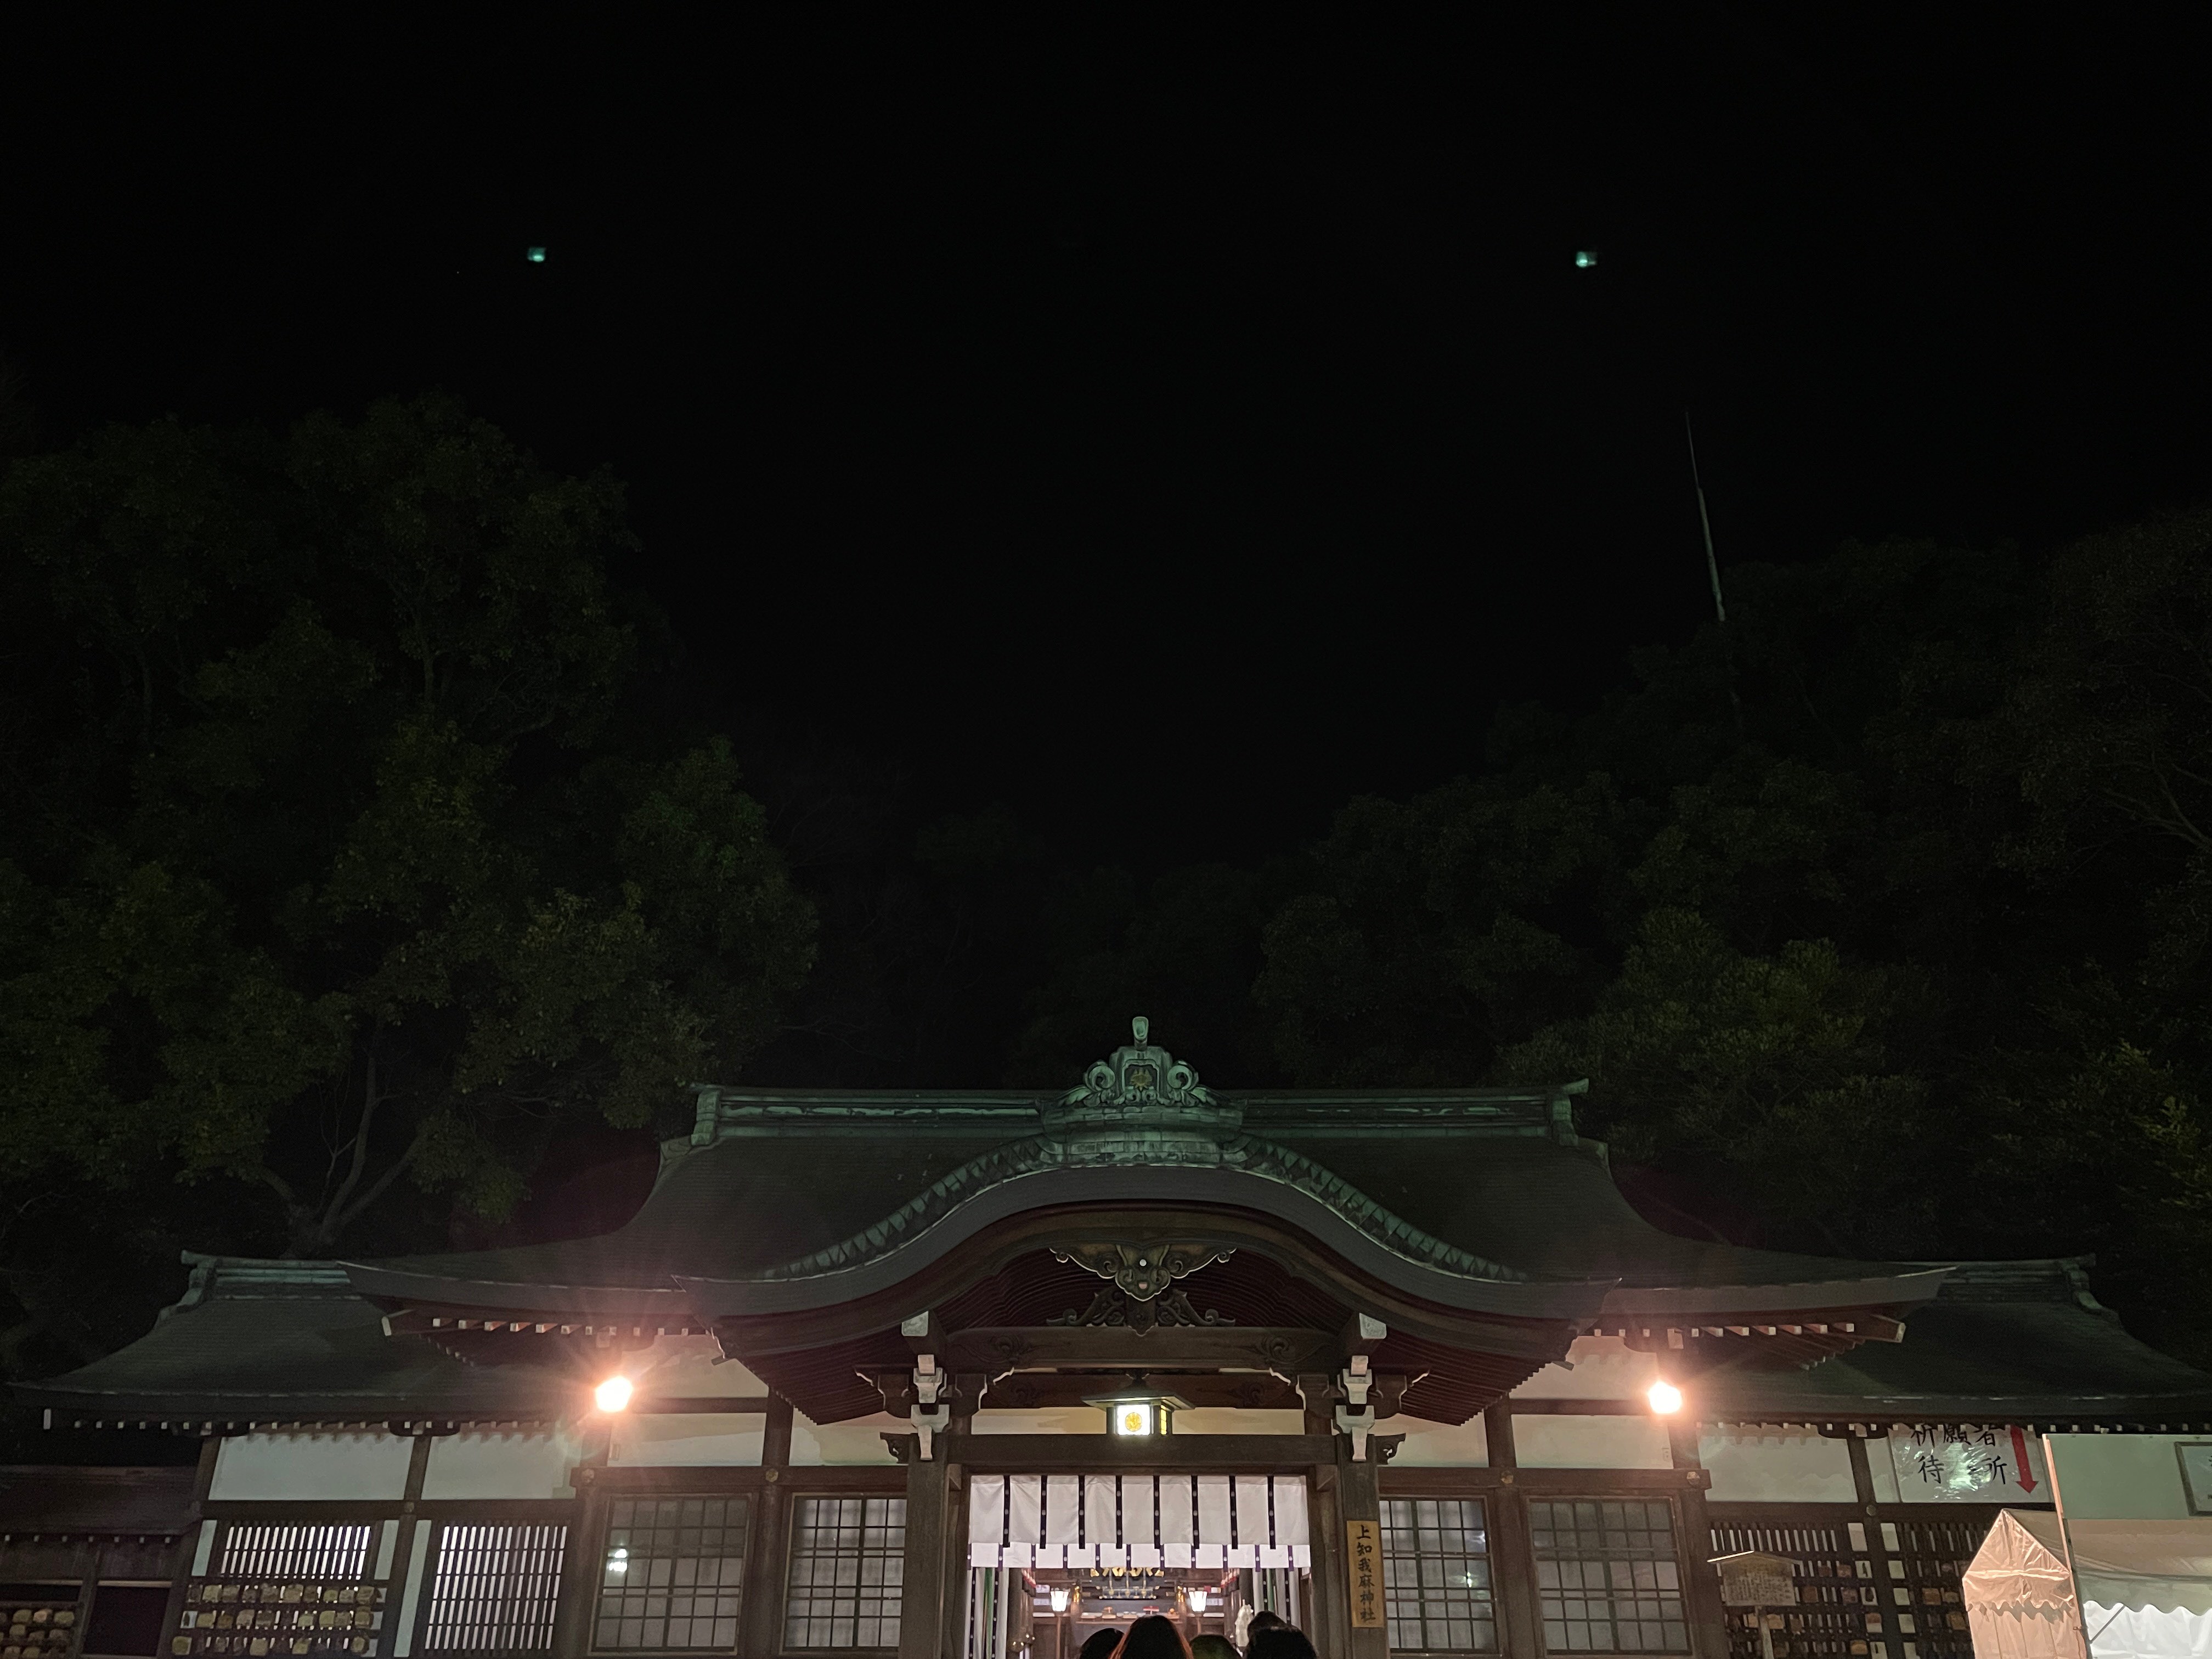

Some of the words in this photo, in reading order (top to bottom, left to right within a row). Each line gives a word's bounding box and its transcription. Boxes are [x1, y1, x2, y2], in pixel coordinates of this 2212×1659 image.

[1918, 1454, 2007, 1485] 待所
[1356, 1525, 1376, 1622] 上知我麻神社
